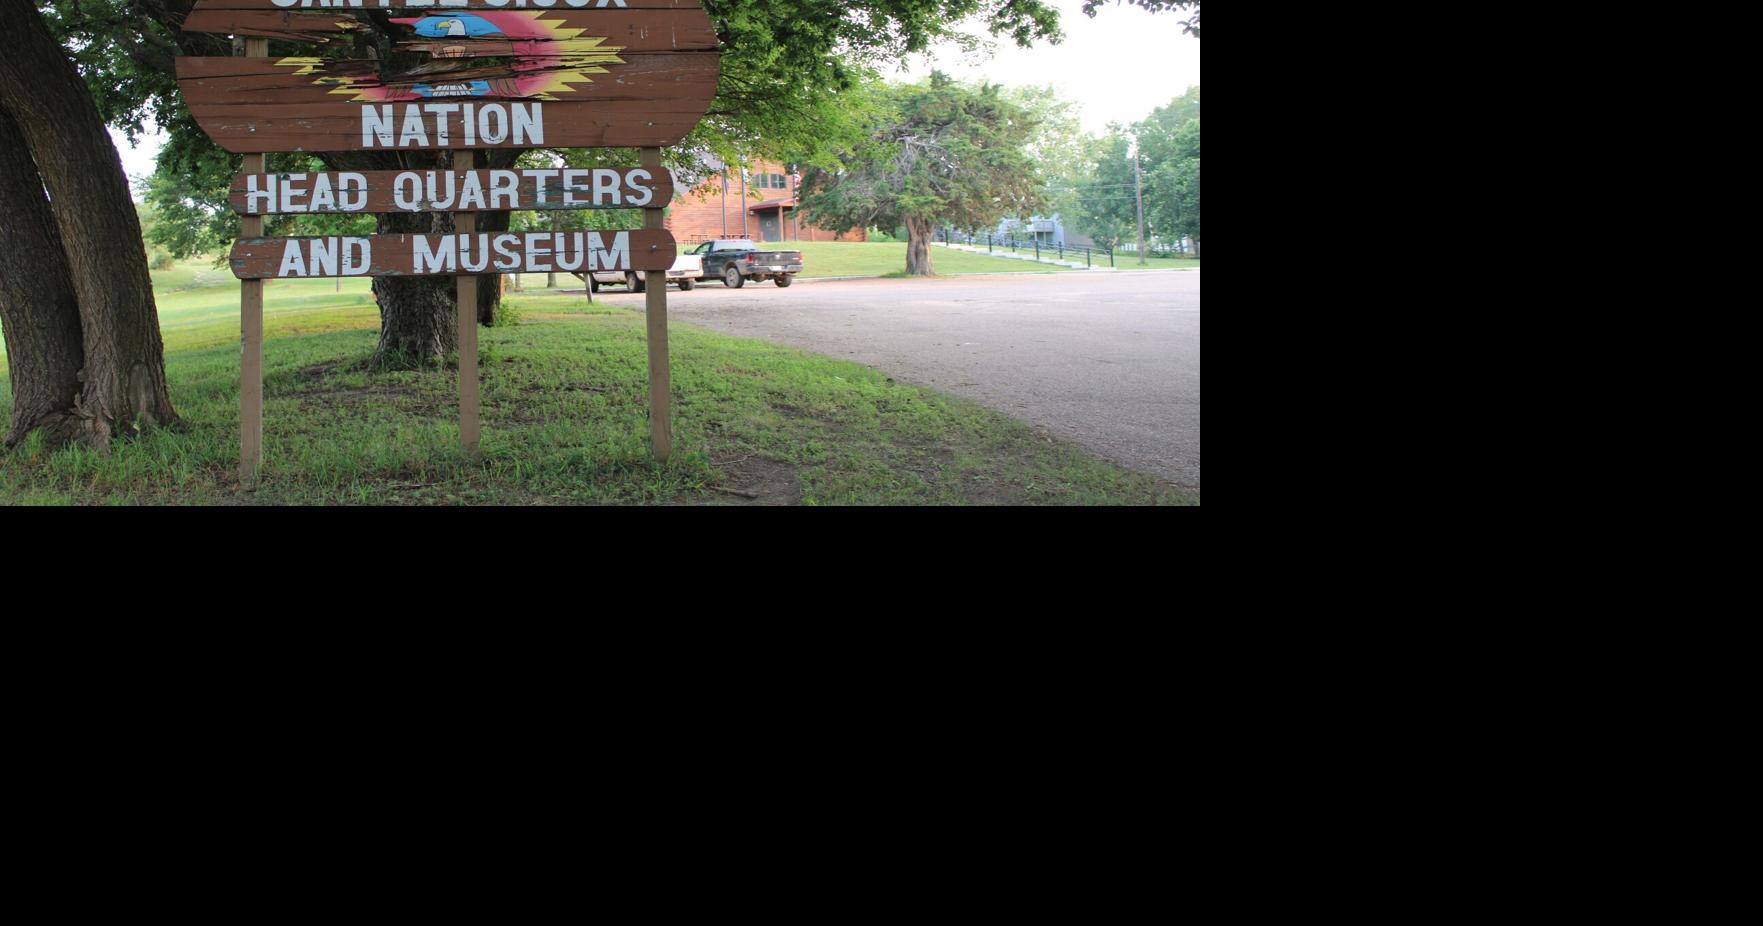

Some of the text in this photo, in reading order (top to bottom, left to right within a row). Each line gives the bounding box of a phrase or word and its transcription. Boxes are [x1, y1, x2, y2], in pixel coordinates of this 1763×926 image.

[362, 102, 544, 147] NATION
[247, 168, 653, 213] HEAD QUARTERS
[278, 231, 630, 277] AND MUSEUM
